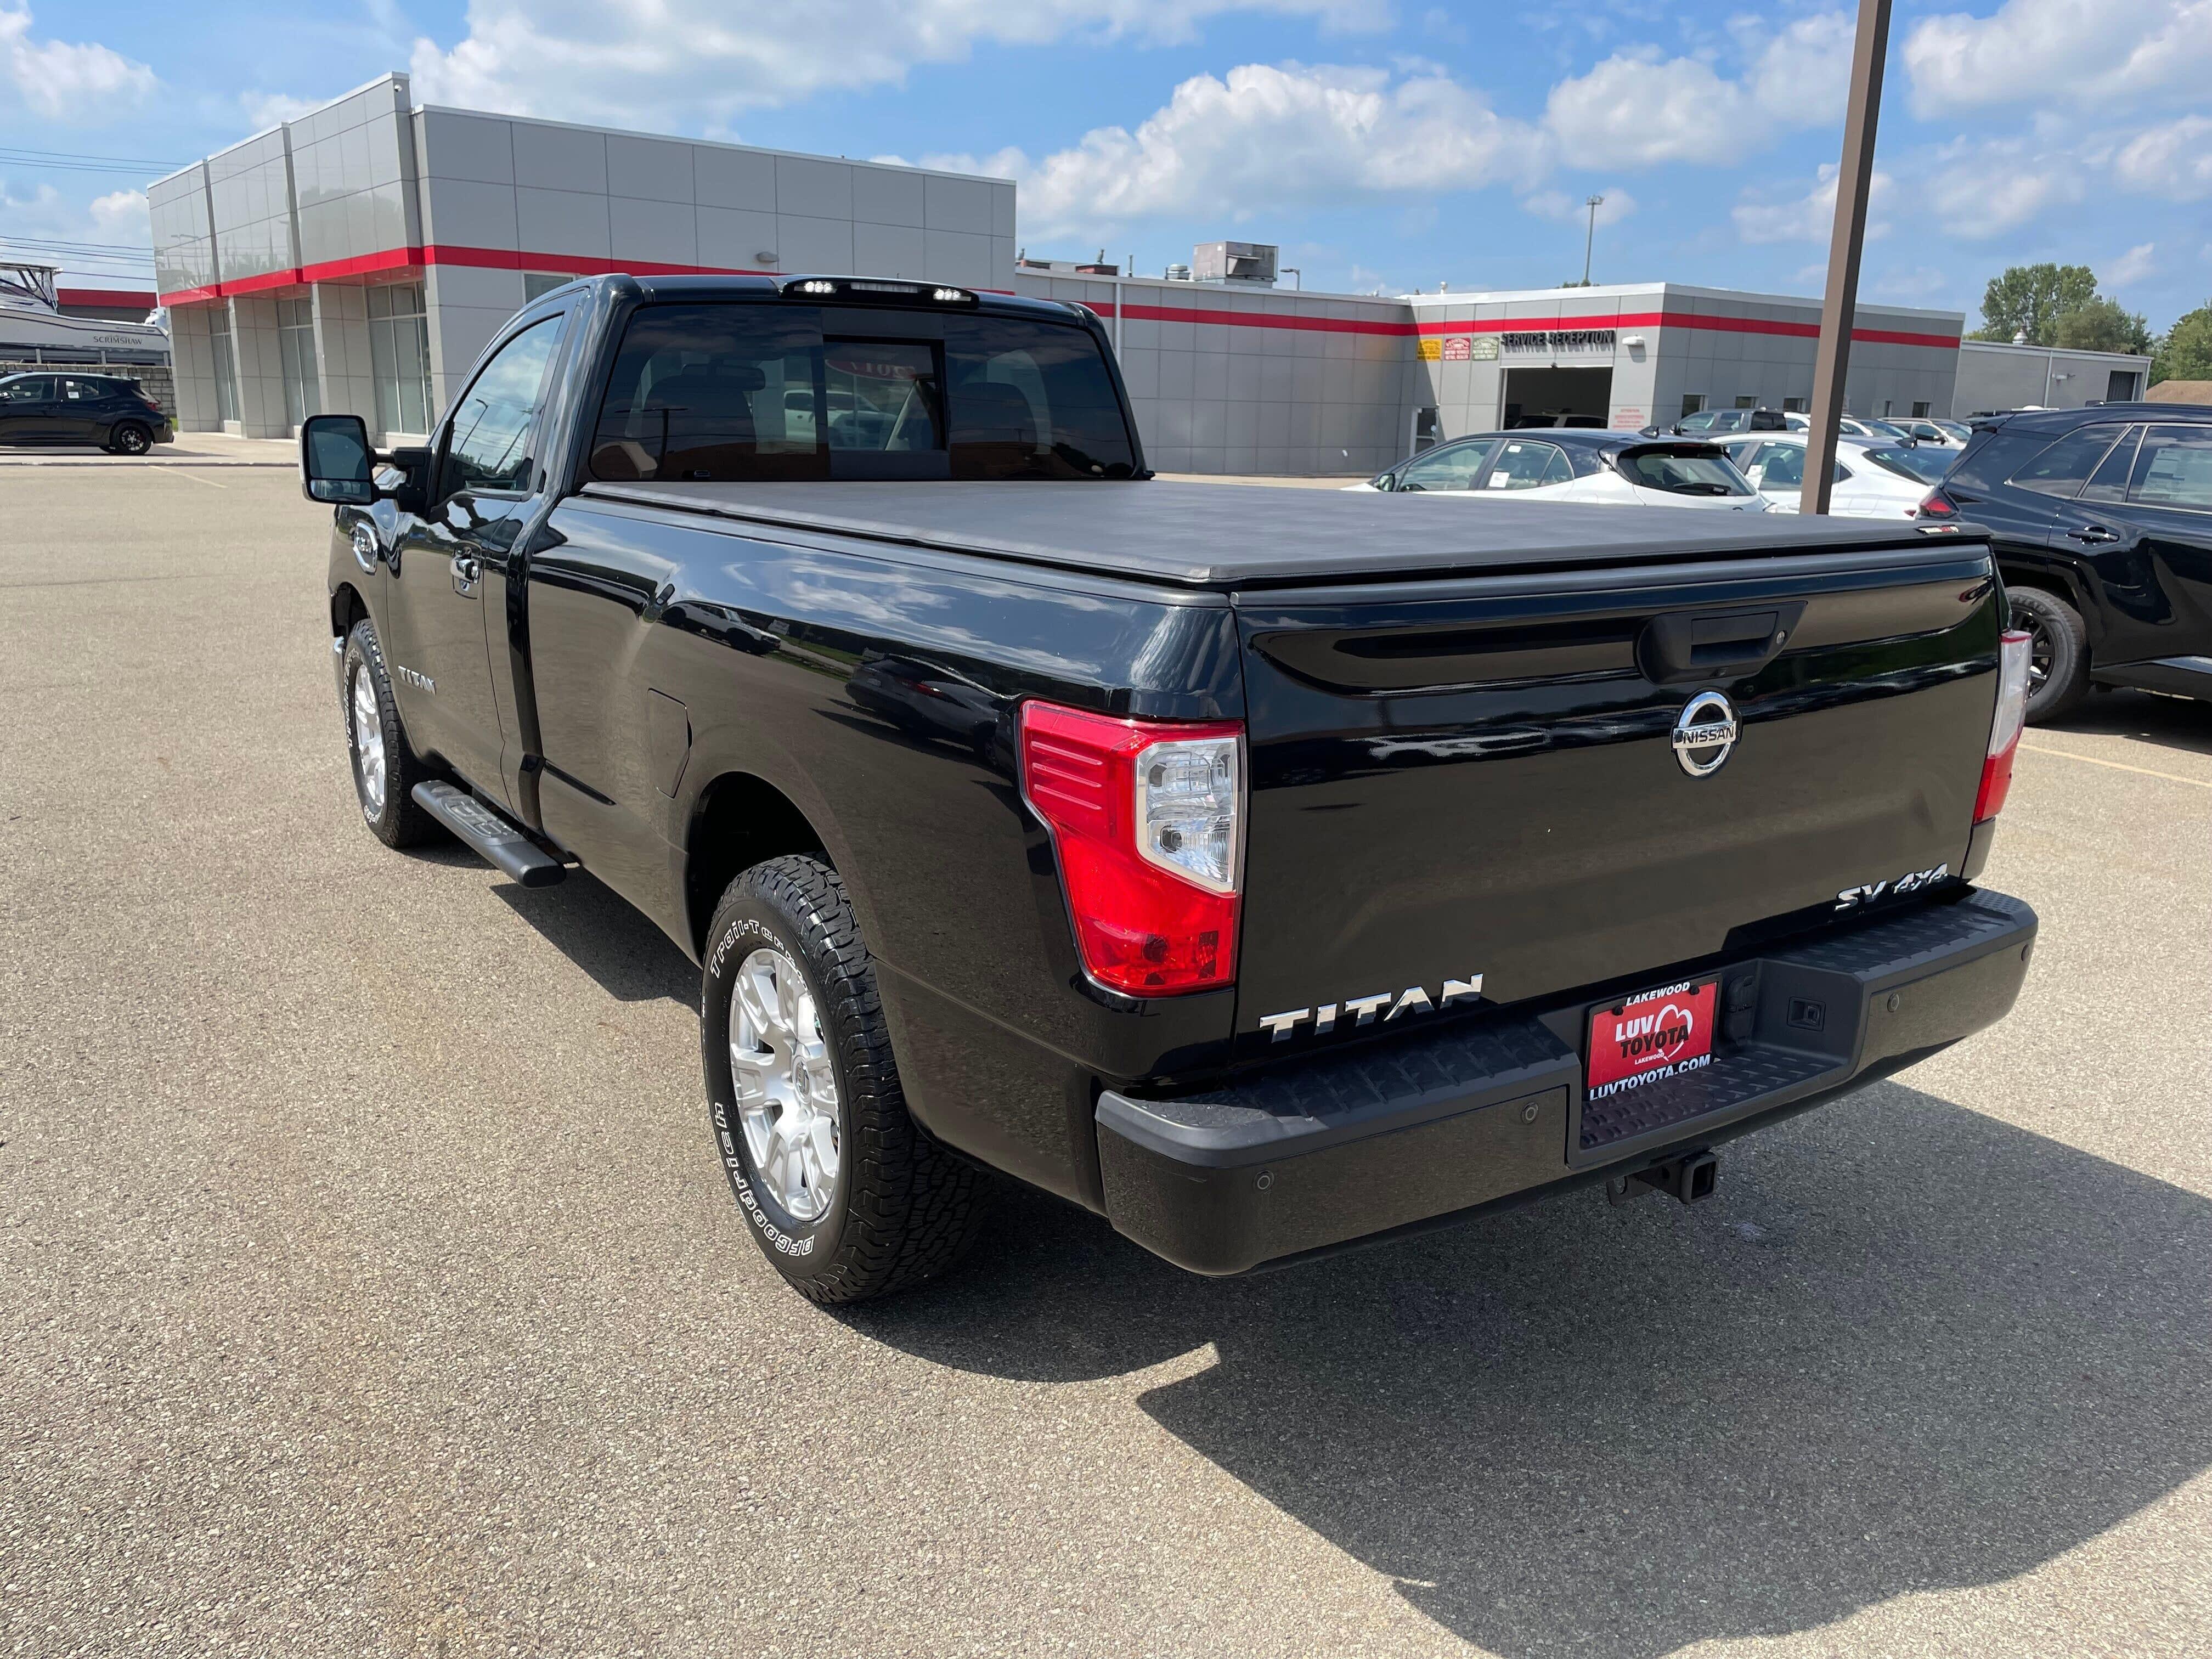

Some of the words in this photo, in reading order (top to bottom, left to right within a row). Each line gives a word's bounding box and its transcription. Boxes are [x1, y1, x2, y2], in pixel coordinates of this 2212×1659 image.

[93, 336, 143, 345] SCRIMSHAW
[1502, 332, 1547, 346] SERVICE
[1548, 330, 1616, 345] RECEPTION
[398, 665, 437, 696] TITAN
[1683, 726, 1734, 744] NISSAN
[1835, 879, 1887, 912] SV
[1260, 973, 1483, 1043] TITAN
[1626, 981, 1690, 1007] LAKEWOOD
[1615, 1014, 1655, 1042] LUV
[1620, 1024, 1689, 1059] TOYOTA
[1634, 1052, 1665, 1065] LAKEWOOD
[1589, 1054, 1711, 1102] LUVTOYOTA.COM
